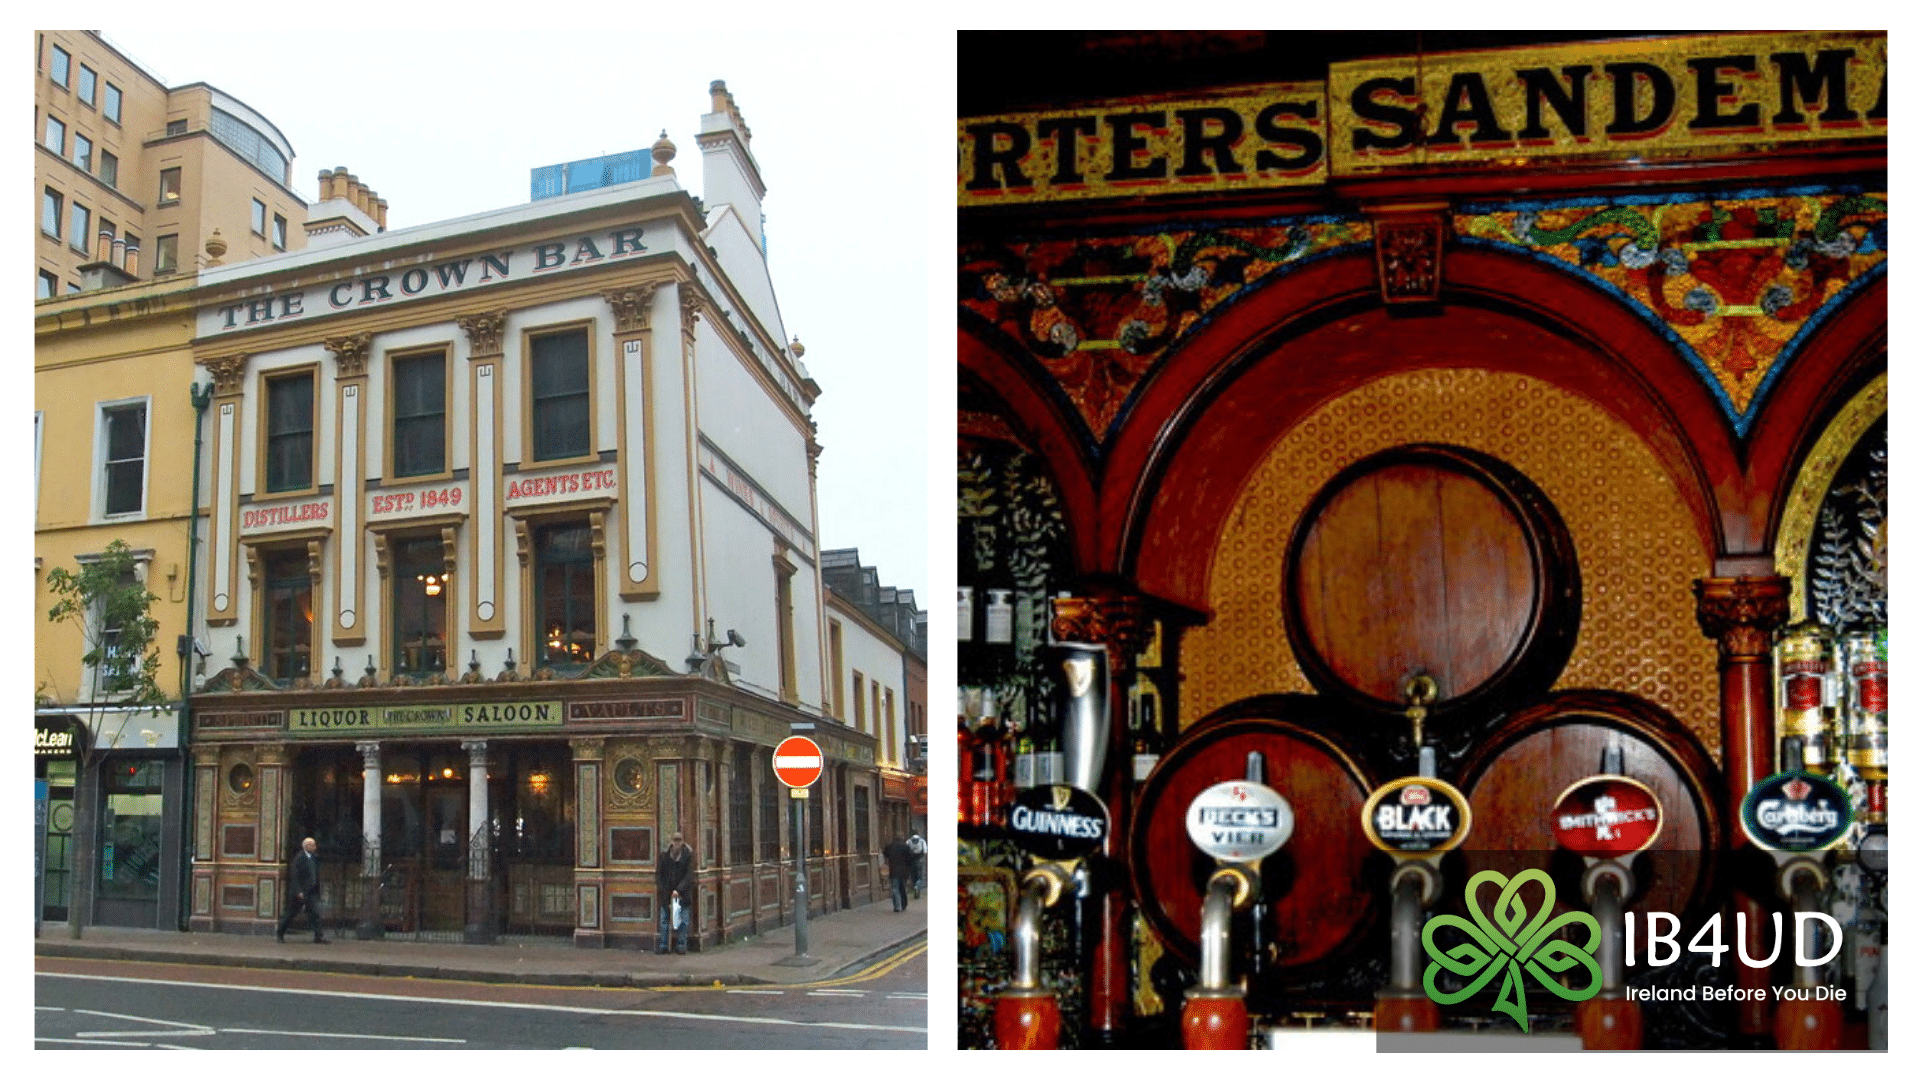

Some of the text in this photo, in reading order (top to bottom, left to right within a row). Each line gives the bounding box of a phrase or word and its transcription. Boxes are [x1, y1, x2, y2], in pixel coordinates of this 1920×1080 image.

[1351, 48, 1888, 154] SANDEM
[957, 100, 1324, 194] RTERS
[218, 227, 648, 330] THE CROWN BAR
[420, 487, 462, 510] 1849
[506, 474, 580, 500] AGENTS
[243, 502, 329, 528] DISTILLERS
[300, 709, 370, 727] LIQUOR
[1012, 805, 1104, 838] GUINNESS
[1378, 804, 1451, 831] BLACK
[1757, 799, 1838, 833] Carlsberg
[1211, 831, 1265, 844] VIER
